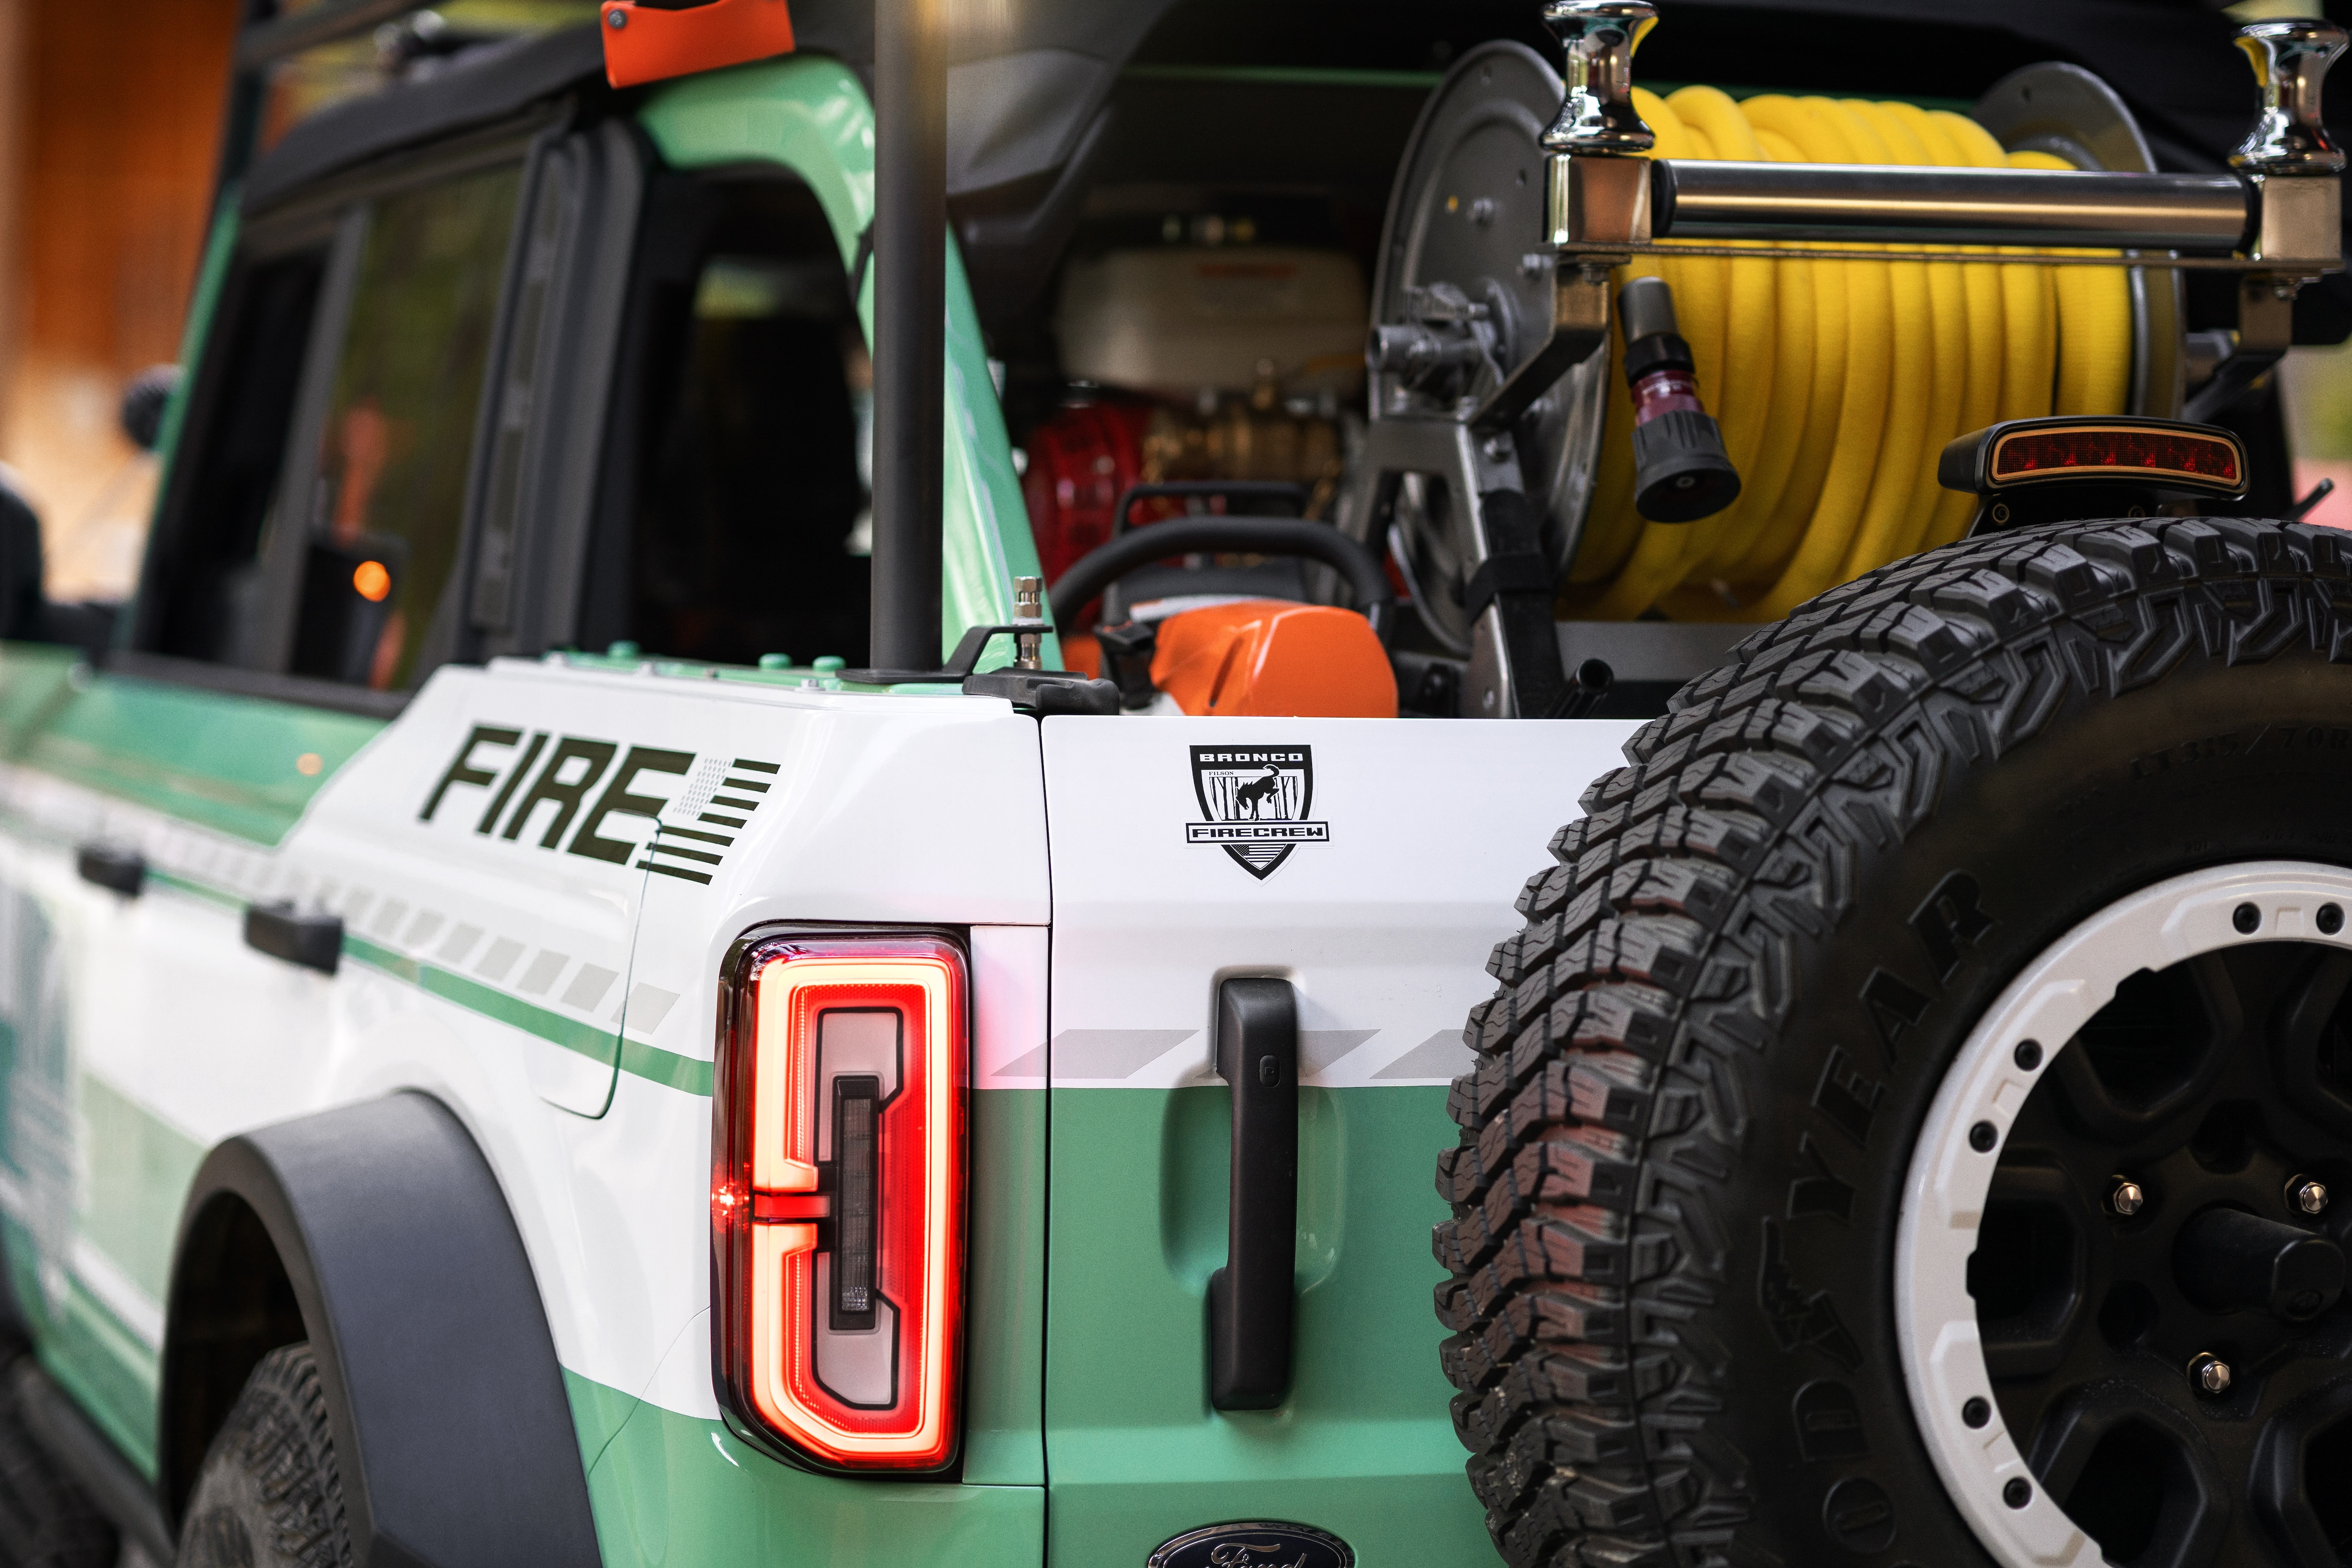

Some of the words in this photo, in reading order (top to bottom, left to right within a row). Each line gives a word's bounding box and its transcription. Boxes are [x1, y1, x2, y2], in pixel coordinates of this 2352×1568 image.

[1200, 753, 1303, 762] BRONCO
[417, 724, 697, 866] FIRE
[1192, 827, 1323, 838] FIRECREW
